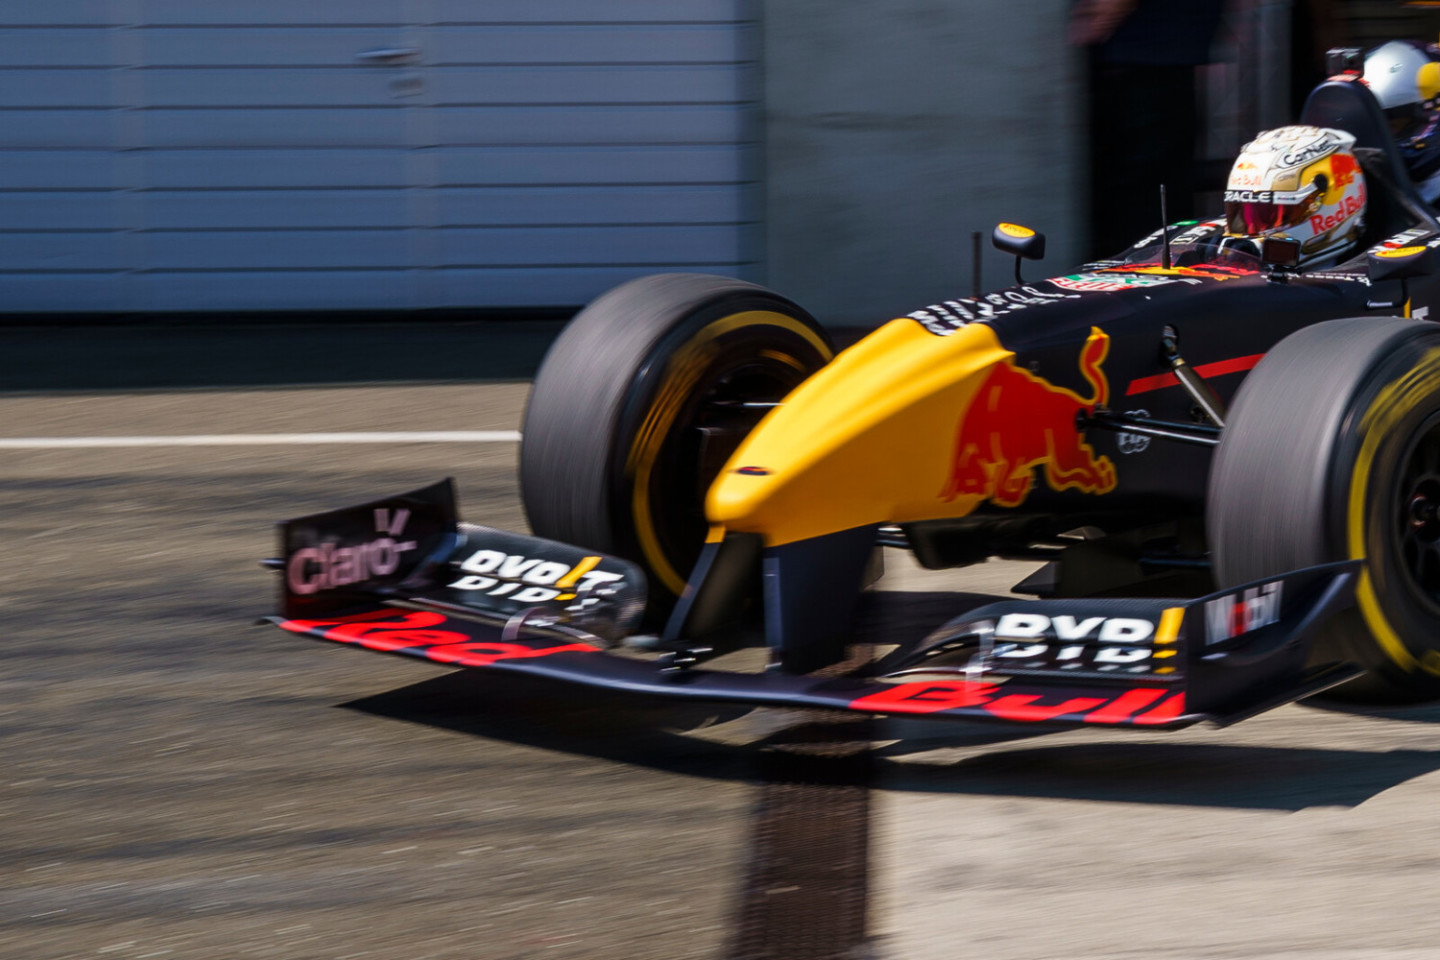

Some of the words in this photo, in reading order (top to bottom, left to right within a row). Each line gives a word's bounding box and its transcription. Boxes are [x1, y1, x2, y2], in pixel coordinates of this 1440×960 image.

[1223, 190, 1271, 203] RACLE
[1311, 203, 1346, 235] Red
[288, 537, 402, 595] Claro
[279, 607, 603, 666] Red
[848, 680, 1186, 724] Bull
